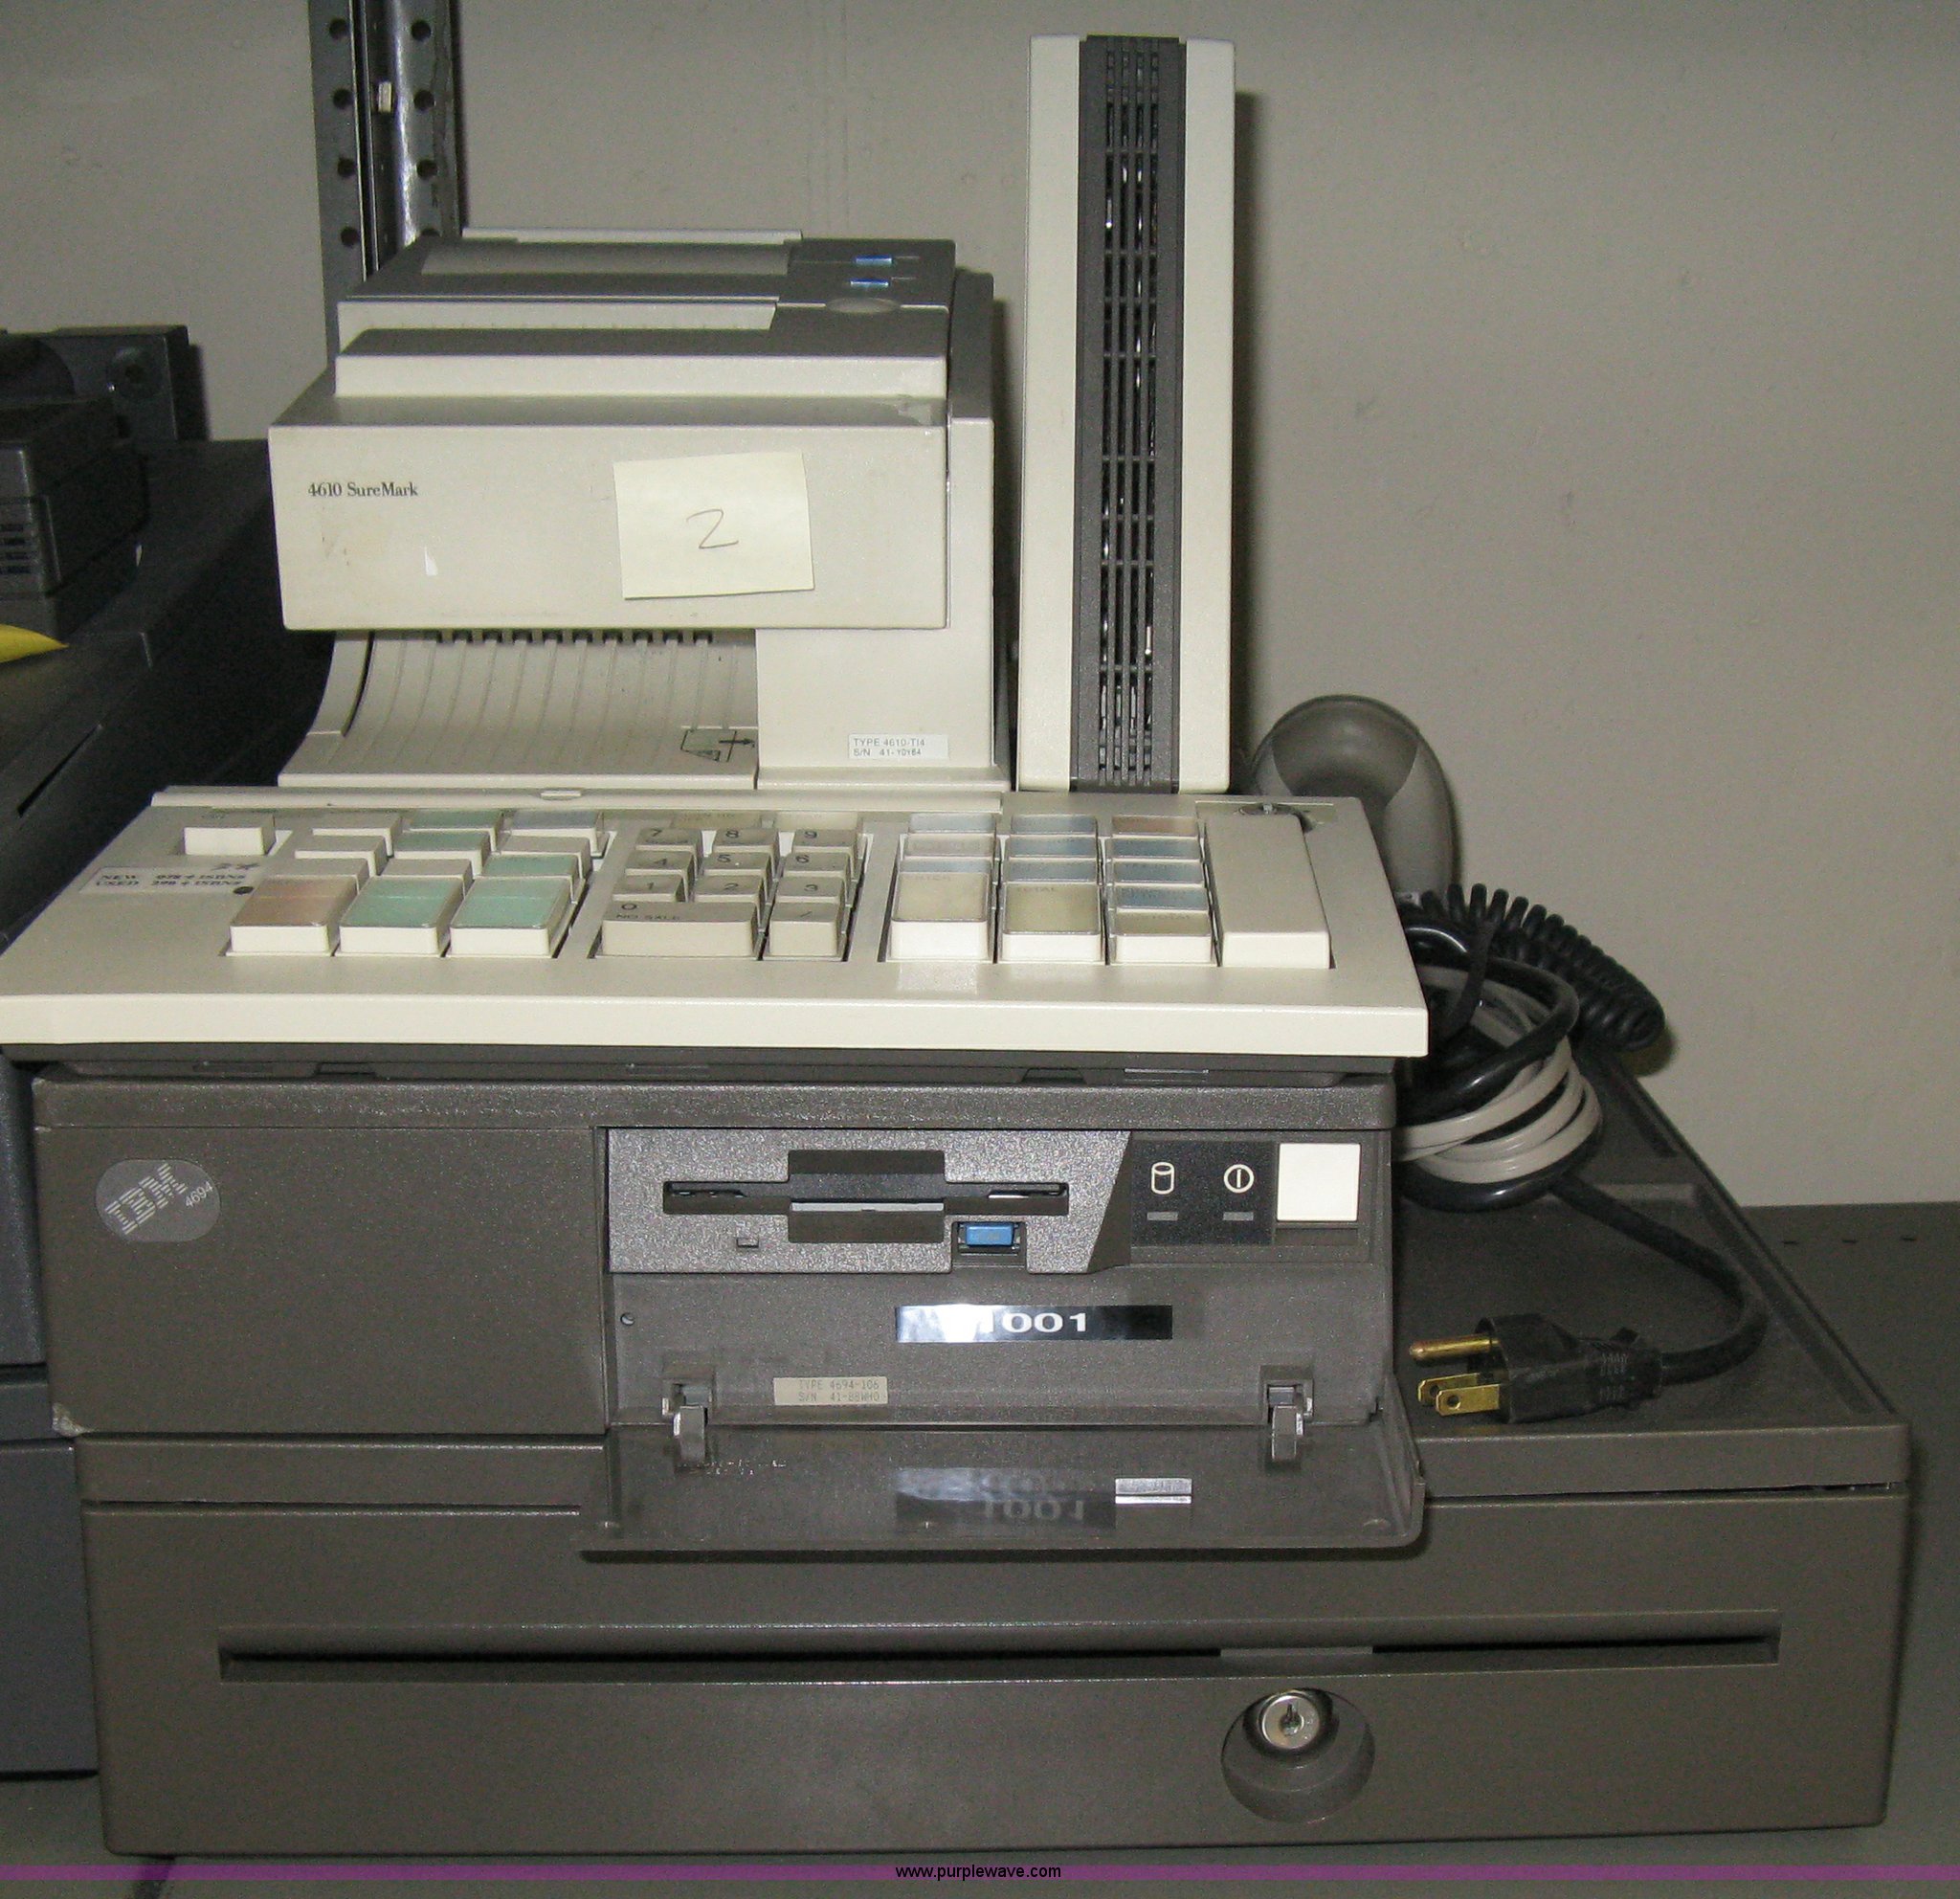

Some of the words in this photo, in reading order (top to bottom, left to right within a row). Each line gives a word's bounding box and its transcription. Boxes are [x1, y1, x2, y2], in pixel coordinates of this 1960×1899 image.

[307, 481, 343, 497] 4610
[346, 481, 418, 497] SureMark
[685, 508, 740, 549] 2
[853, 737, 880, 747] TYPE
[650, 828, 662, 838] 7
[725, 829, 740, 839] 8
[804, 830, 818, 839] 9
[717, 854, 732, 863] 5
[795, 854, 810, 863] 6
[723, 882, 740, 892] 2
[804, 883, 818, 893] 3
[104, 1162, 189, 1235] IBM
[185, 1180, 213, 1208] 4694
[798, 1379, 823, 1390] TYPE
